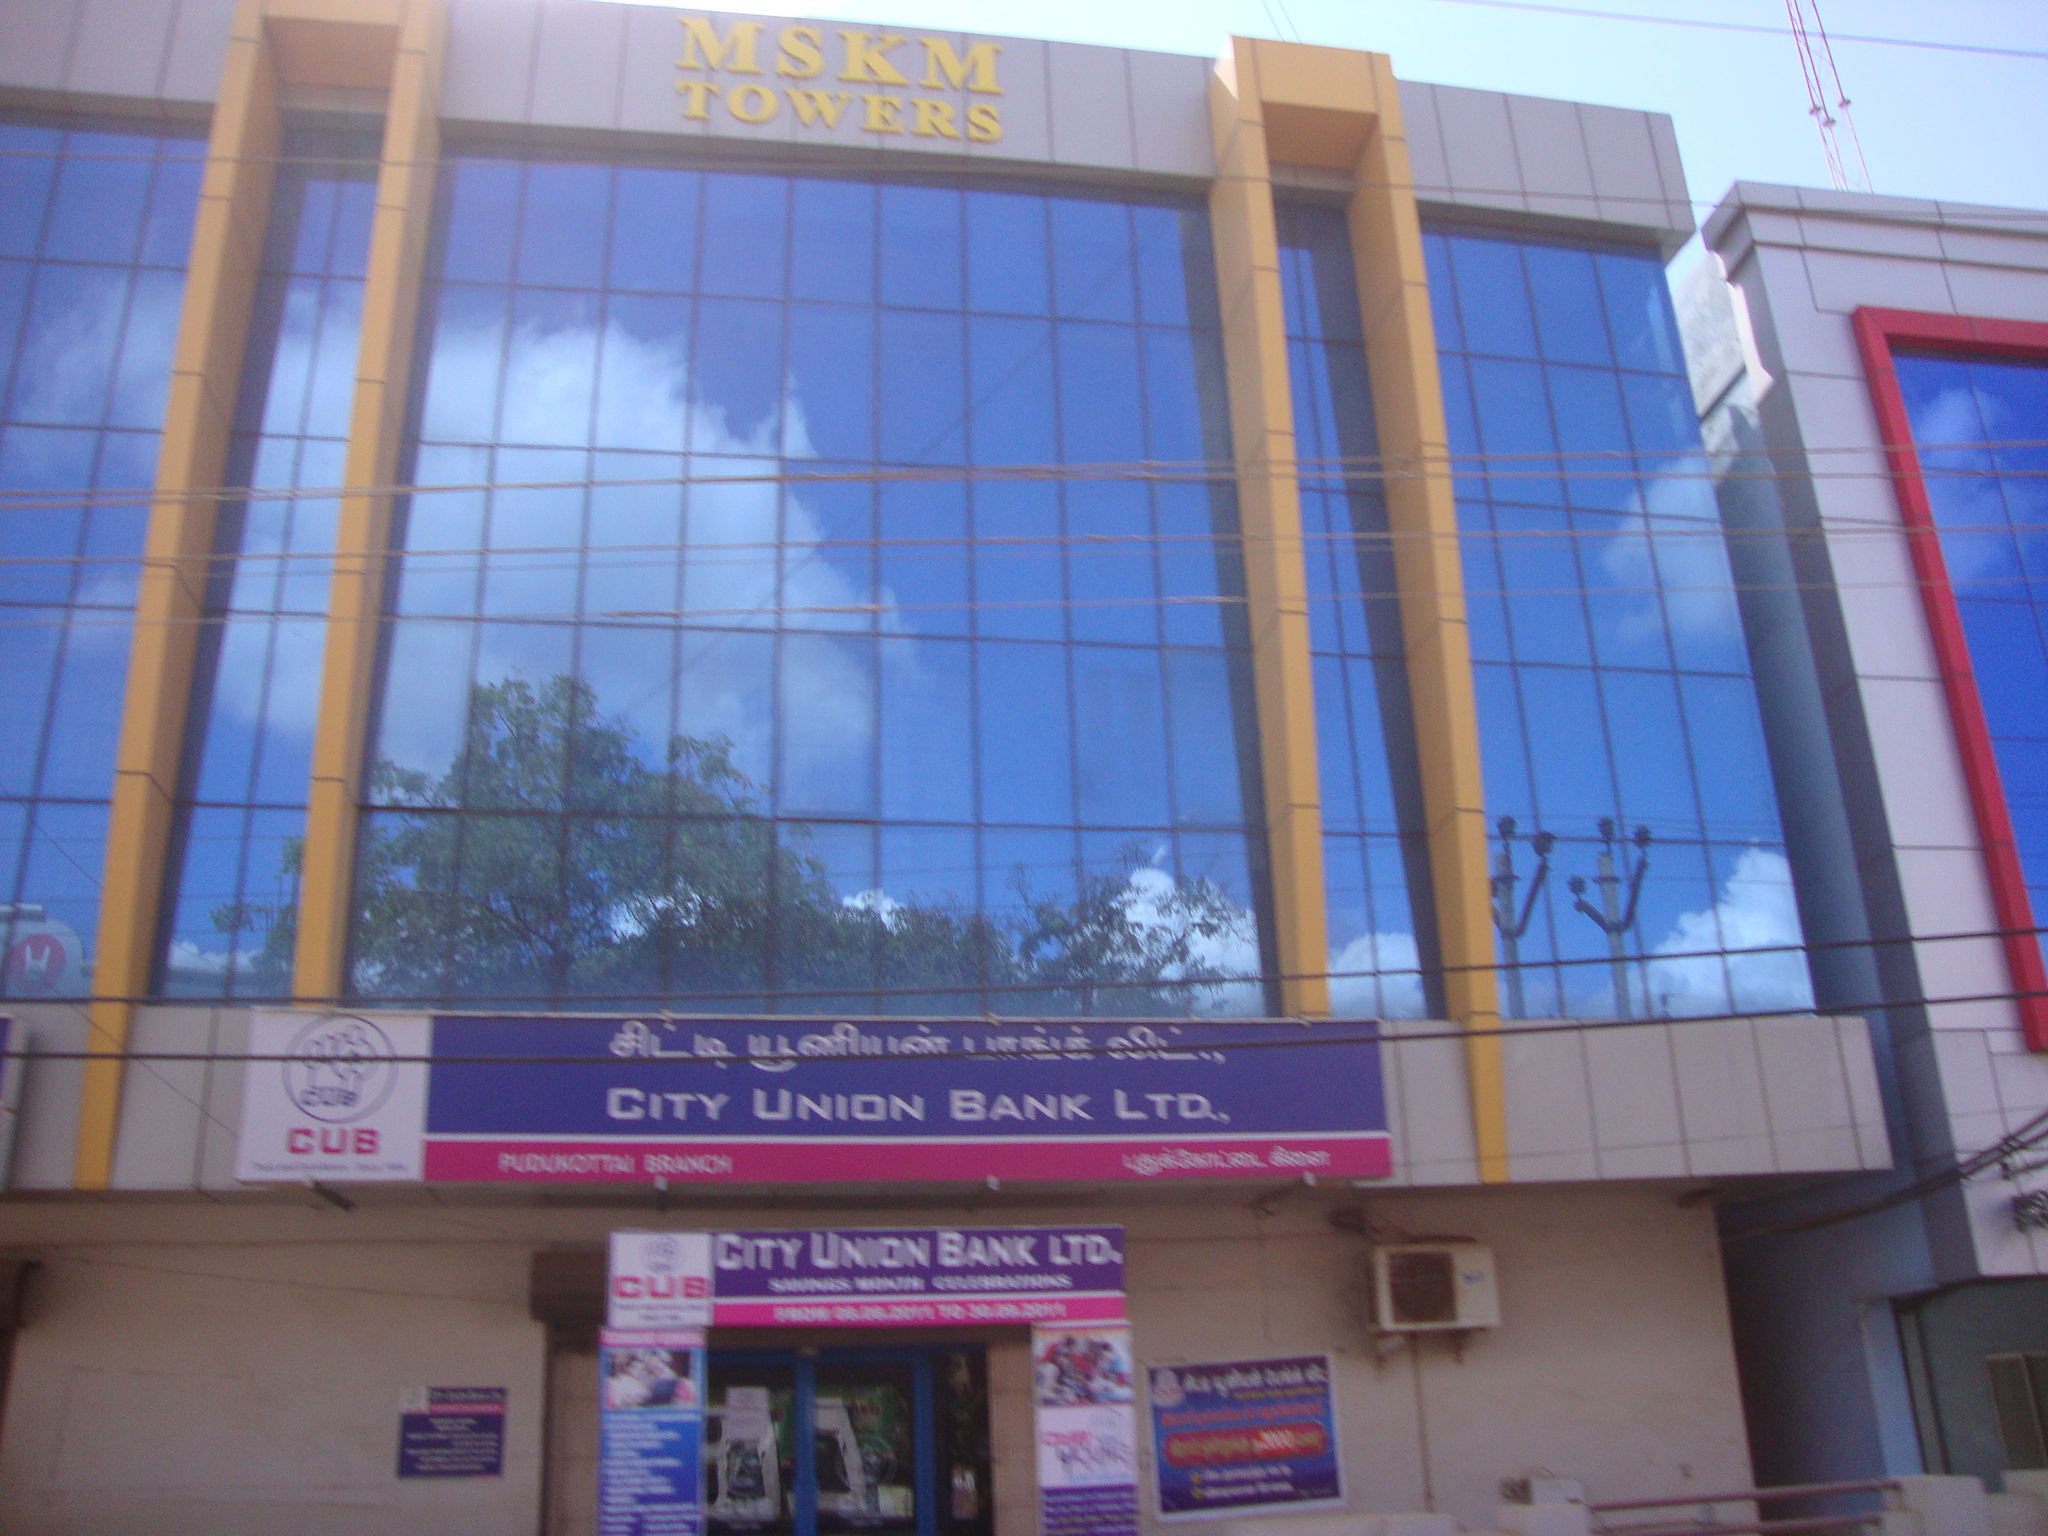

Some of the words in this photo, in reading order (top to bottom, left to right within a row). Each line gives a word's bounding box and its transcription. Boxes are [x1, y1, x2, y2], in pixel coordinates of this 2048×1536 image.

[676, 16, 1004, 95] MSKM
[675, 80, 1003, 142] TOWERS
[606, 1087, 731, 1120] CITY
[752, 1088, 925, 1121] UNION
[948, 1088, 1095, 1121] BANK
[286, 1127, 379, 1155] CUB
[497, 1152, 635, 1174] PUDUKOTTAI
[643, 1153, 733, 1175] BRANCH
[715, 1232, 804, 1270] CITY
[810, 1231, 931, 1269] UNION
[936, 1231, 1040, 1268] BANK
[613, 1275, 709, 1298] CUB
